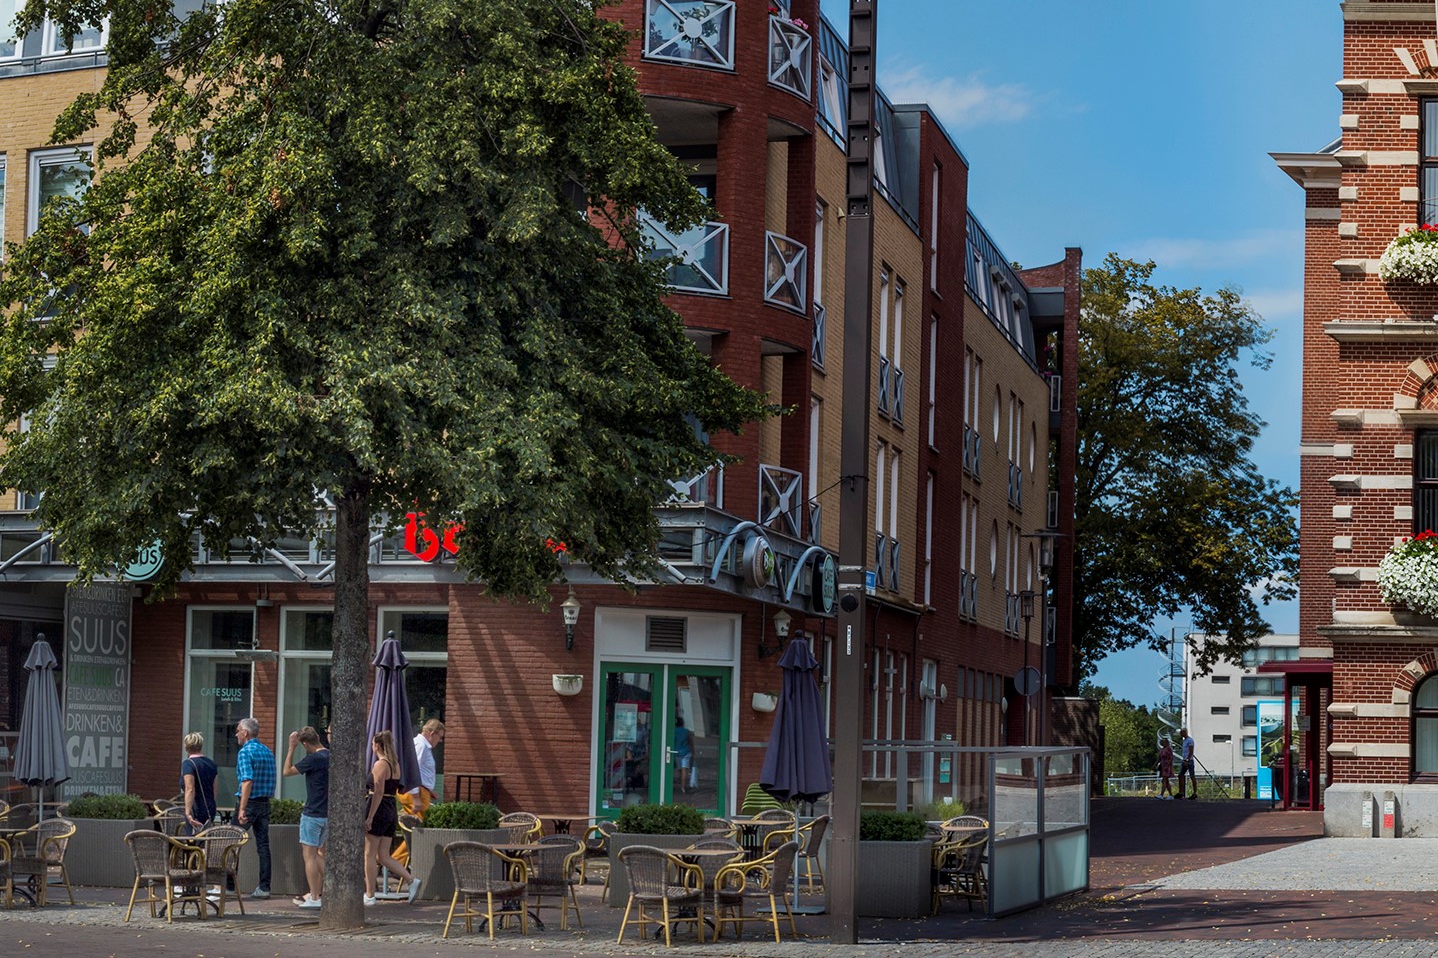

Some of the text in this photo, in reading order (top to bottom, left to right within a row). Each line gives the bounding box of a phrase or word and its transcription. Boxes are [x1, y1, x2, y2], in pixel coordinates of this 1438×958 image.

[70, 616, 127, 655] SUUS
[70, 663, 125, 687] CAFE SUUS CA
[68, 687, 125, 702] ETEN&DRINKEN
[200, 687, 242, 697] CAFE SUUS
[66, 713, 124, 733] DRINKEN&
[66, 735, 124, 768] CAFE
